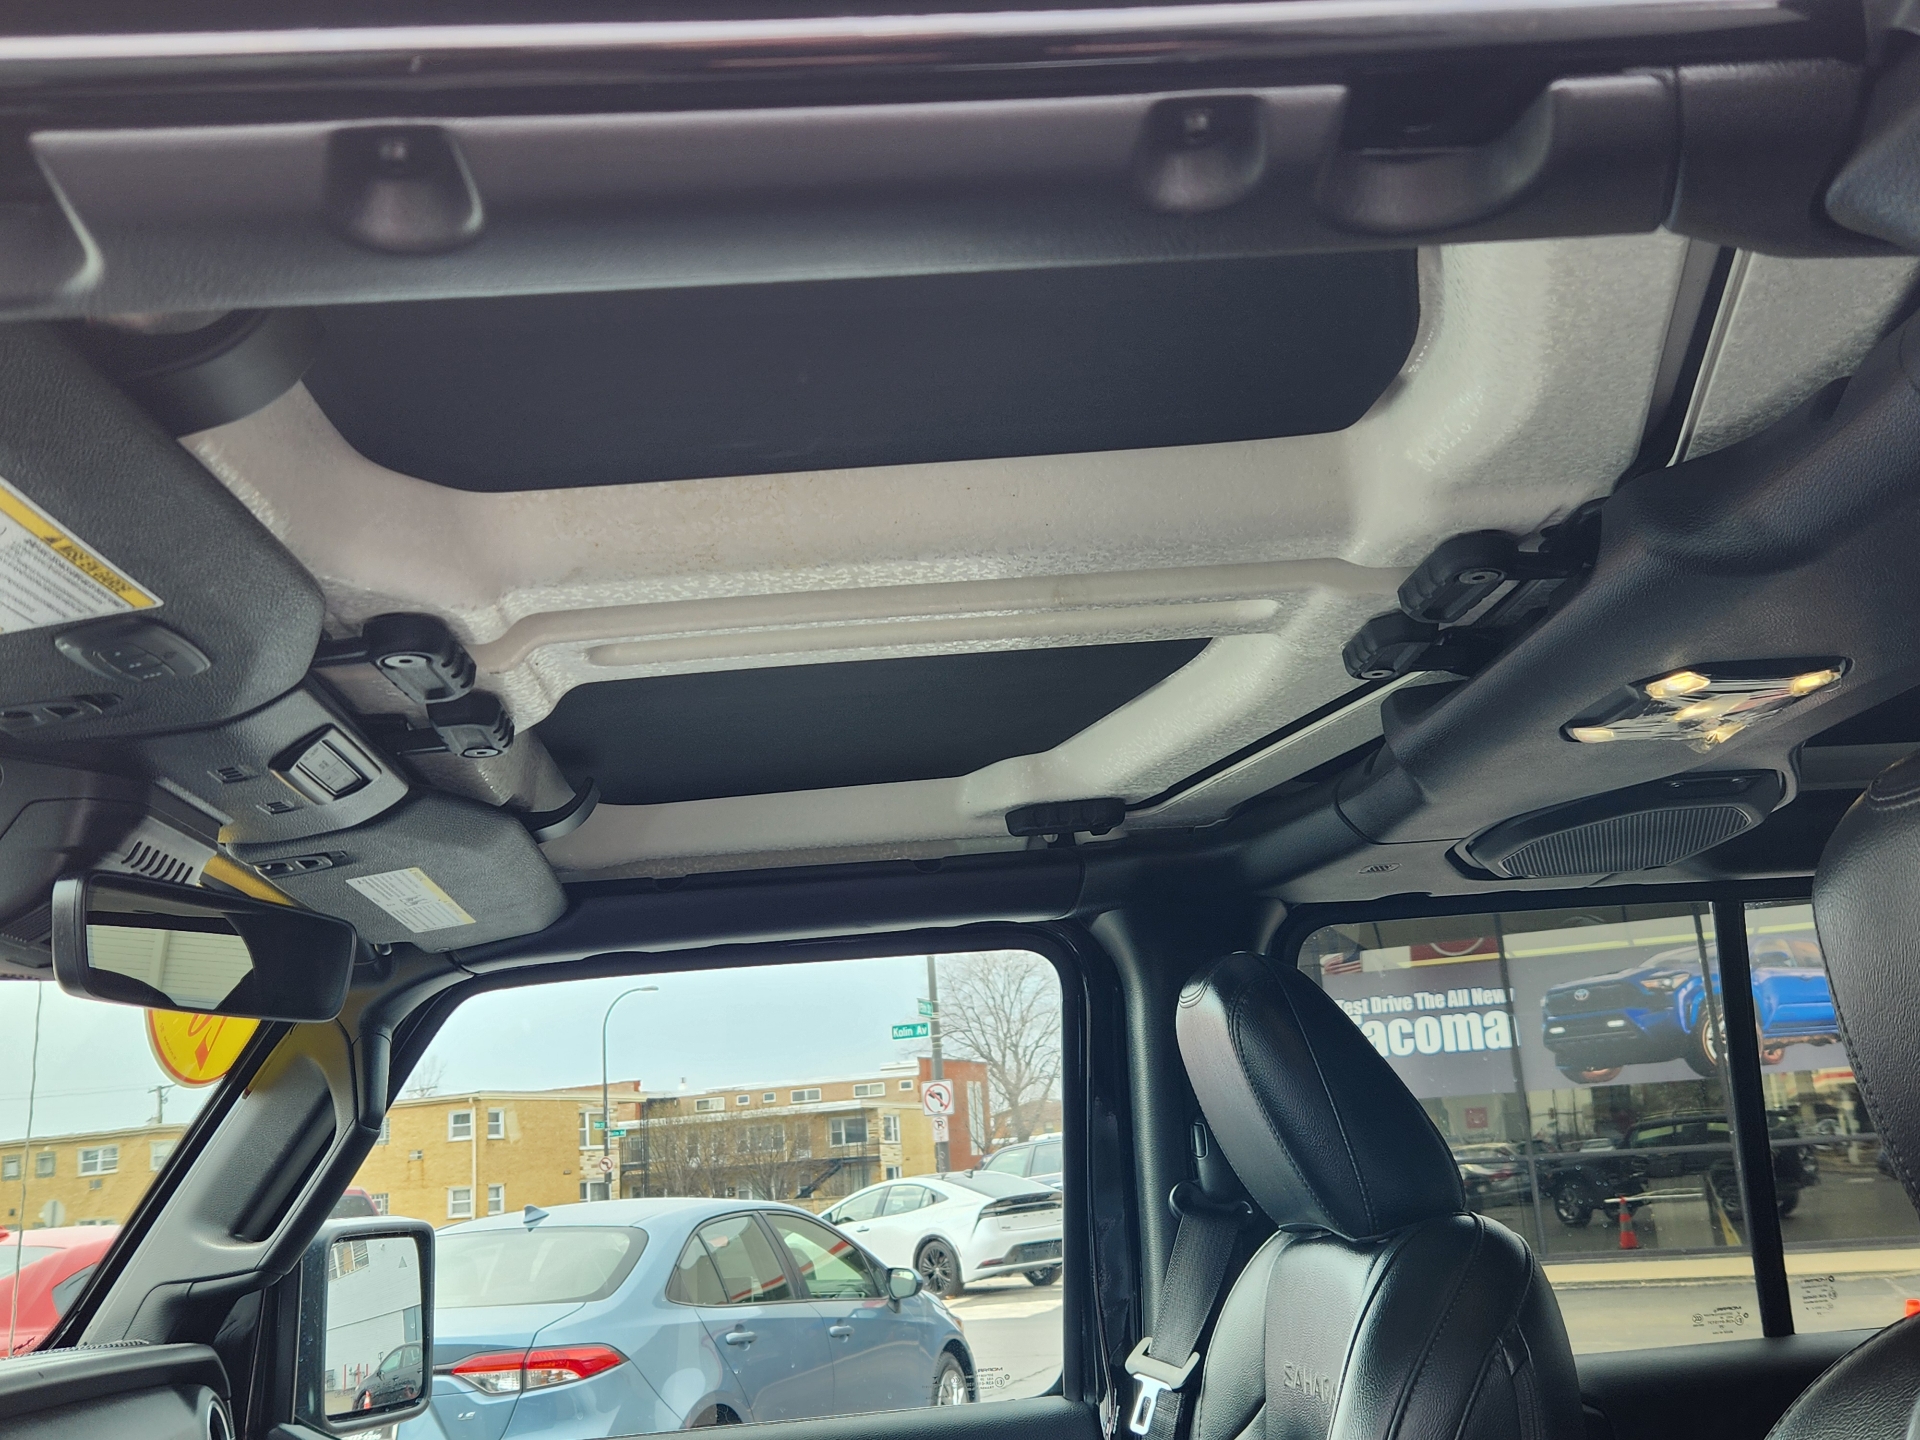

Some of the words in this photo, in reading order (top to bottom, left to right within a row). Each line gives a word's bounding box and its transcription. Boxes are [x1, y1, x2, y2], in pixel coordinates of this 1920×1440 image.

[1336, 999, 1370, 1015] Test
[1370, 995, 1414, 1013] Drive
[1414, 992, 1446, 1010] The
[1447, 989, 1470, 1007] All
[1470, 987, 1514, 1006] New
[893, 1026, 914, 1038] Kolin
[917, 1025, 927, 1036] Av
